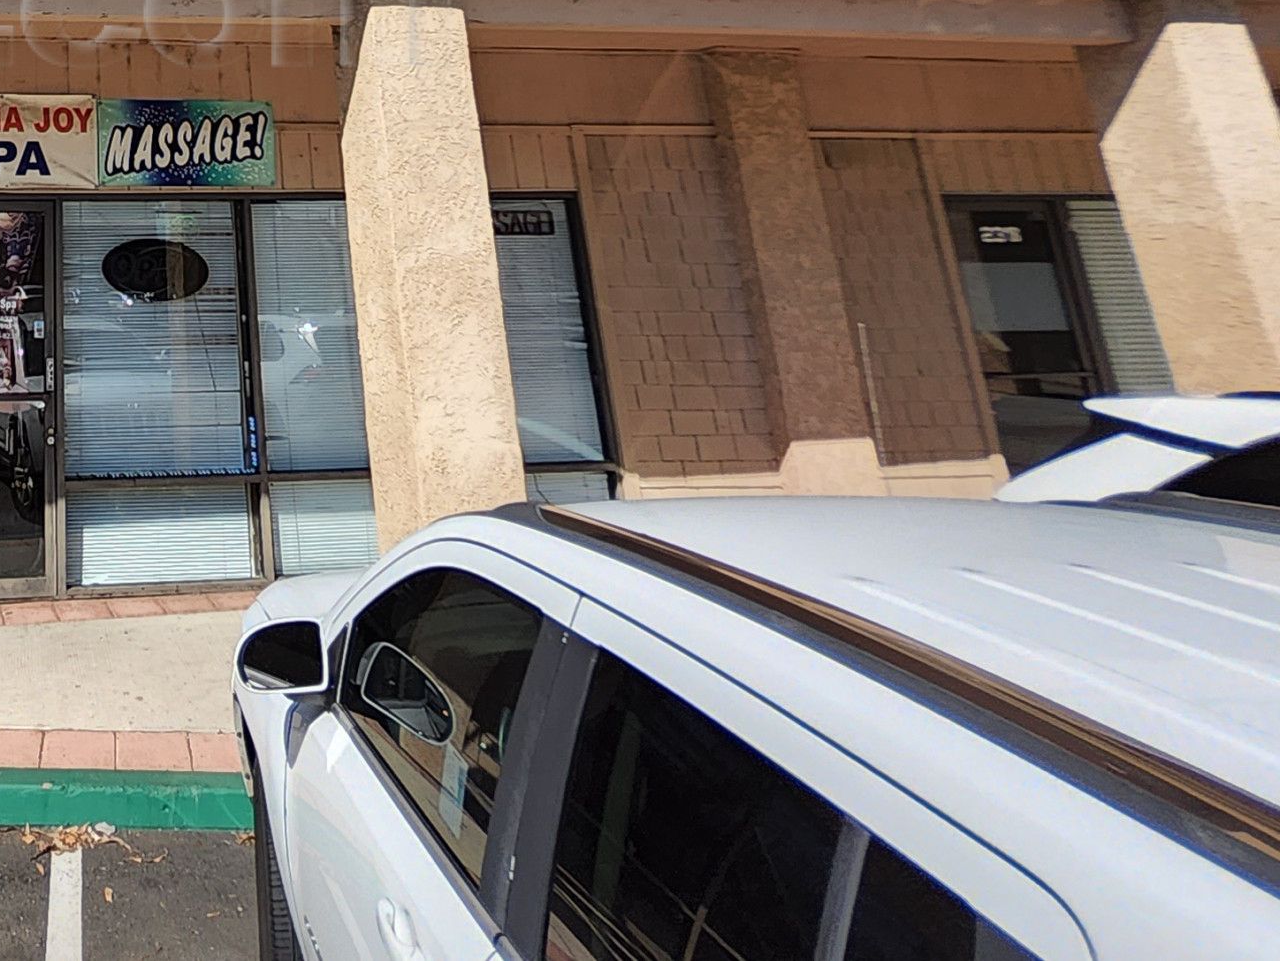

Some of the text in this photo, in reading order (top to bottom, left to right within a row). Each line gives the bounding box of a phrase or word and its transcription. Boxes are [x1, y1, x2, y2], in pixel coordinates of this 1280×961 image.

[34, 107, 93, 133] JOY
[105, 112, 267, 176] MASSAGE!
[0, 299, 16, 311] Spa
